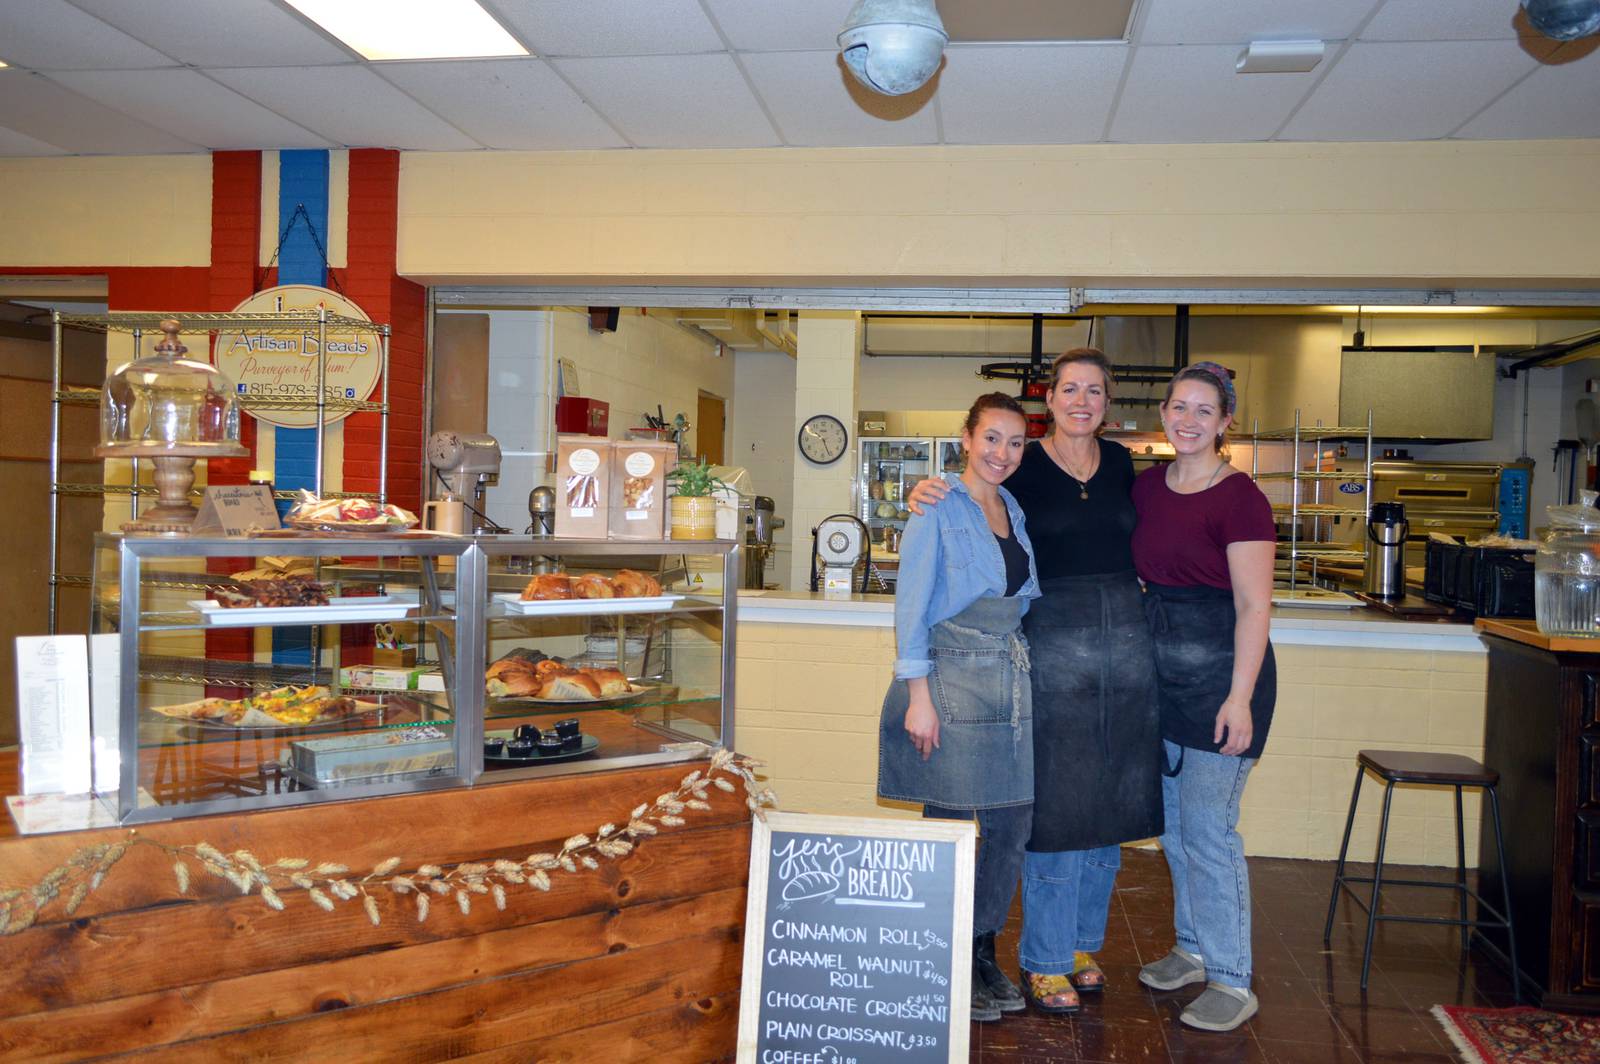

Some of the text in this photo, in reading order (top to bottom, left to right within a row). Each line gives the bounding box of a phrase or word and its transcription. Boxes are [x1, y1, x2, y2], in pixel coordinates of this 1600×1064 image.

[230, 328, 368, 355] Artisan Beads
[240, 356, 298, 384] Purveyor
[315, 356, 358, 383] um!
[250, 383, 342, 398] 815-978-385
[1343, 482, 1361, 492] ABS
[860, 840, 936, 872] ARTISAN
[848, 867, 914, 900] BREADS
[772, 919, 867, 944] CINNAMON
[879, 927, 920, 946] ROLL
[767, 948, 847, 971] CARAMEL
[857, 955, 924, 977] WALNUT
[830, 971, 874, 989] ROLL
[766, 991, 948, 1023] CHOCOLATE CROISSANT
[766, 1020, 813, 1040] PLAIN
[817, 1023, 904, 1047] CROISSANT
[832, 1056, 857, 1064] $100
